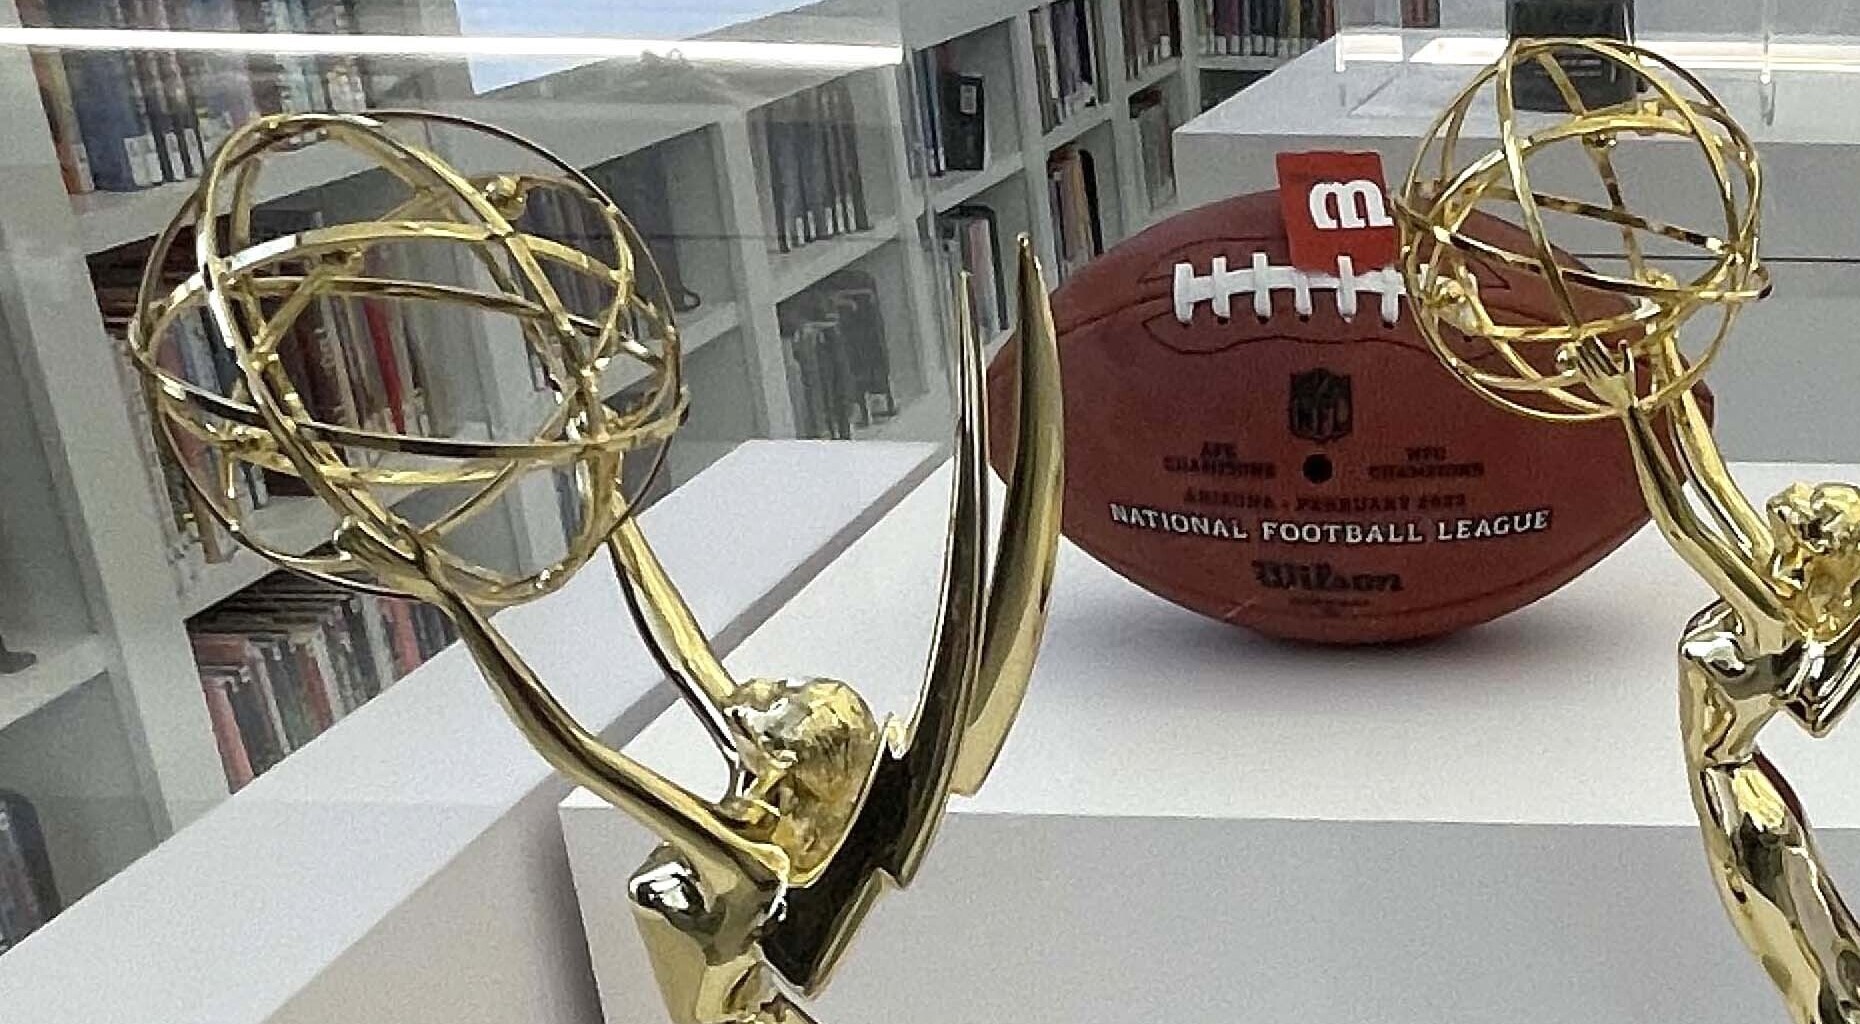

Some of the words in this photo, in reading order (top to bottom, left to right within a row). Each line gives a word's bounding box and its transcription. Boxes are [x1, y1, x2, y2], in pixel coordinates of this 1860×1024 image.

[1109, 502, 1248, 540] NATIONAL
[1261, 521, 1423, 544] FOOTBALL
[1436, 509, 1551, 542] LEAGUE
[1252, 559, 1404, 592] Wilson
